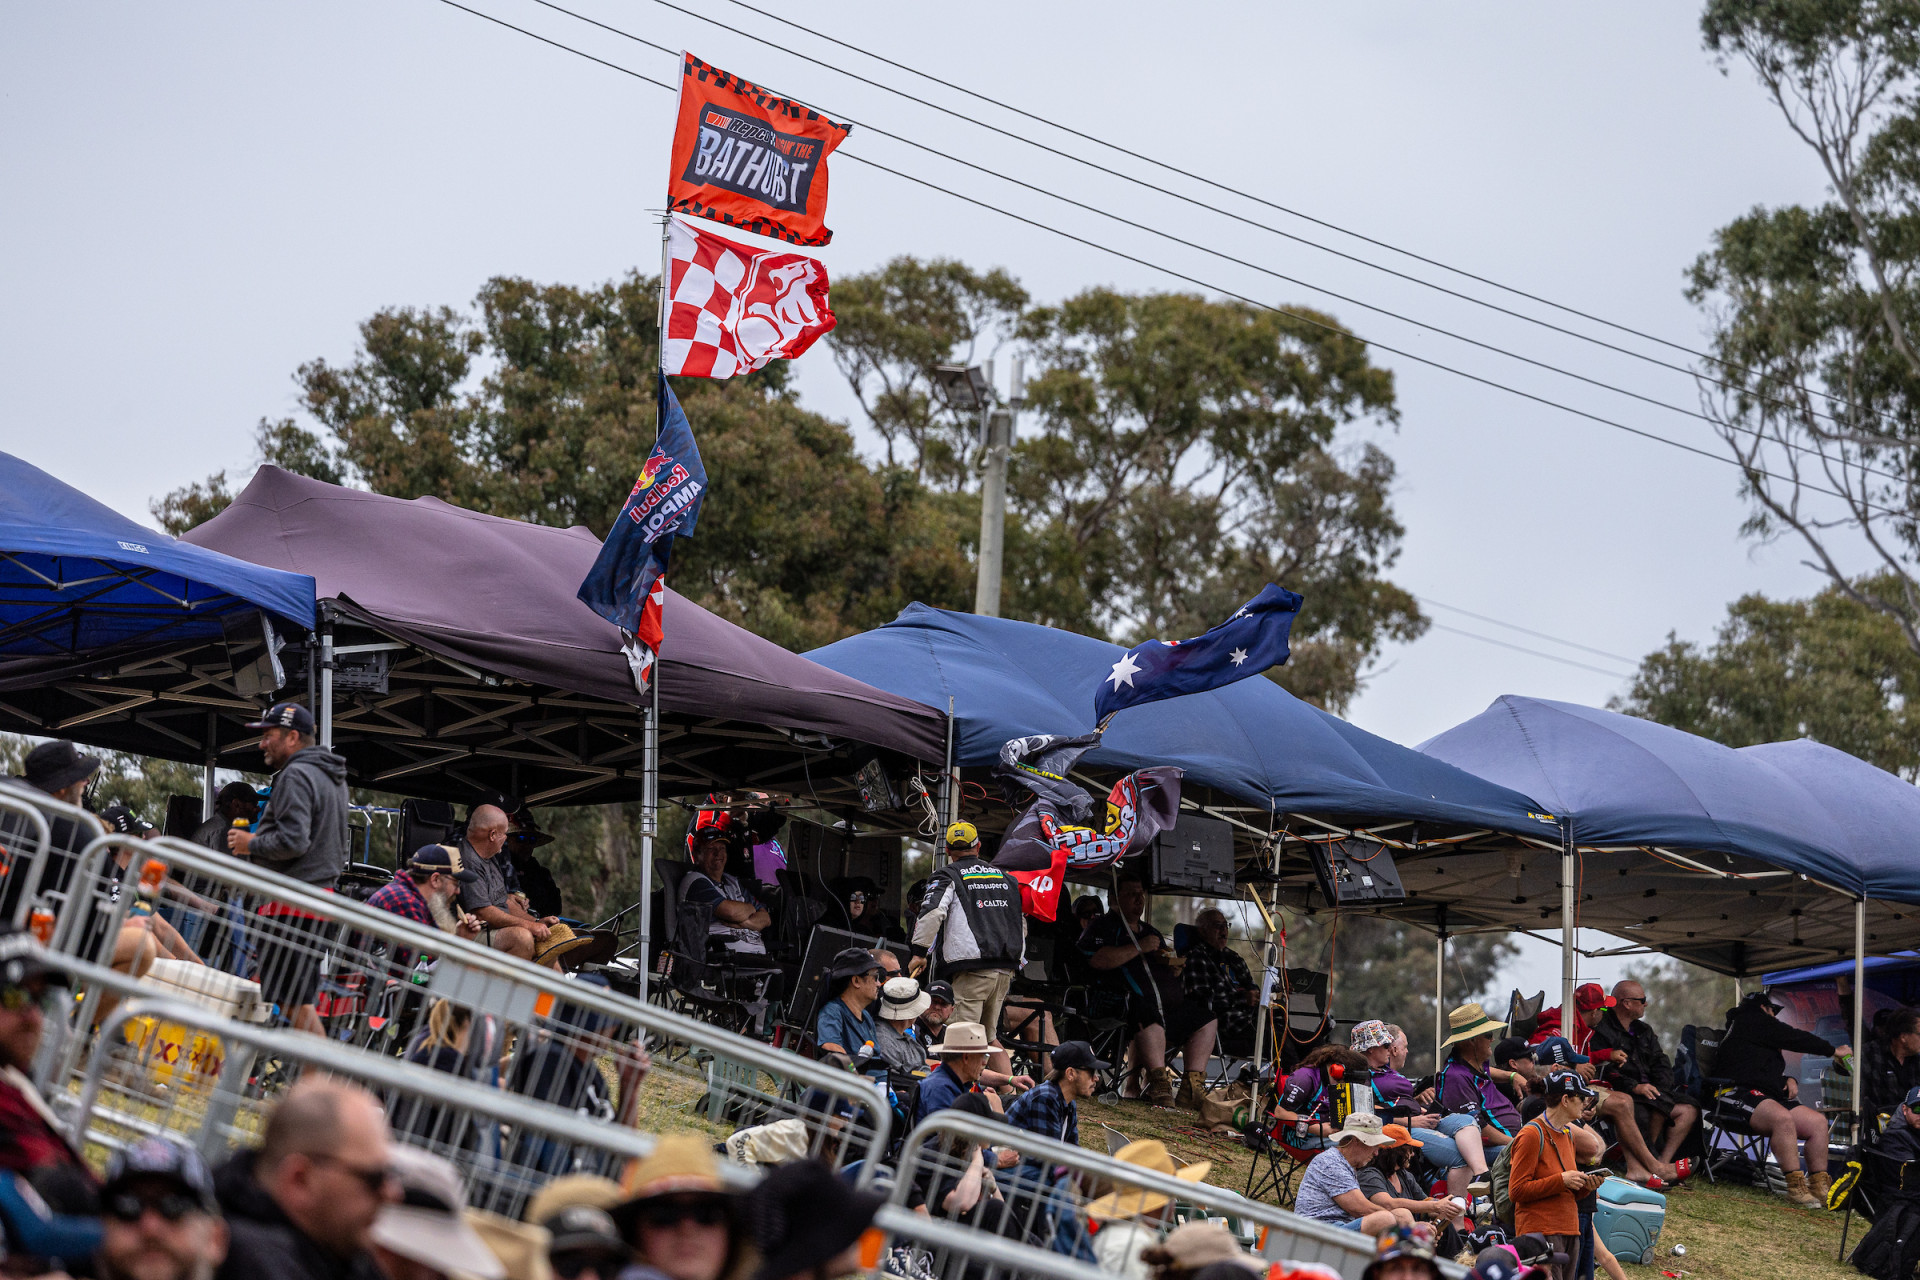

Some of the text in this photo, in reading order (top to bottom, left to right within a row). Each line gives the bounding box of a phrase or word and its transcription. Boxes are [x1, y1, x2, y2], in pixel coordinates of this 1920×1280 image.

[728, 117, 770, 142] Repco
[794, 142, 815, 159] THE
[694, 125, 808, 204] BATHURST
[983, 899, 1008, 907] CALTEX
